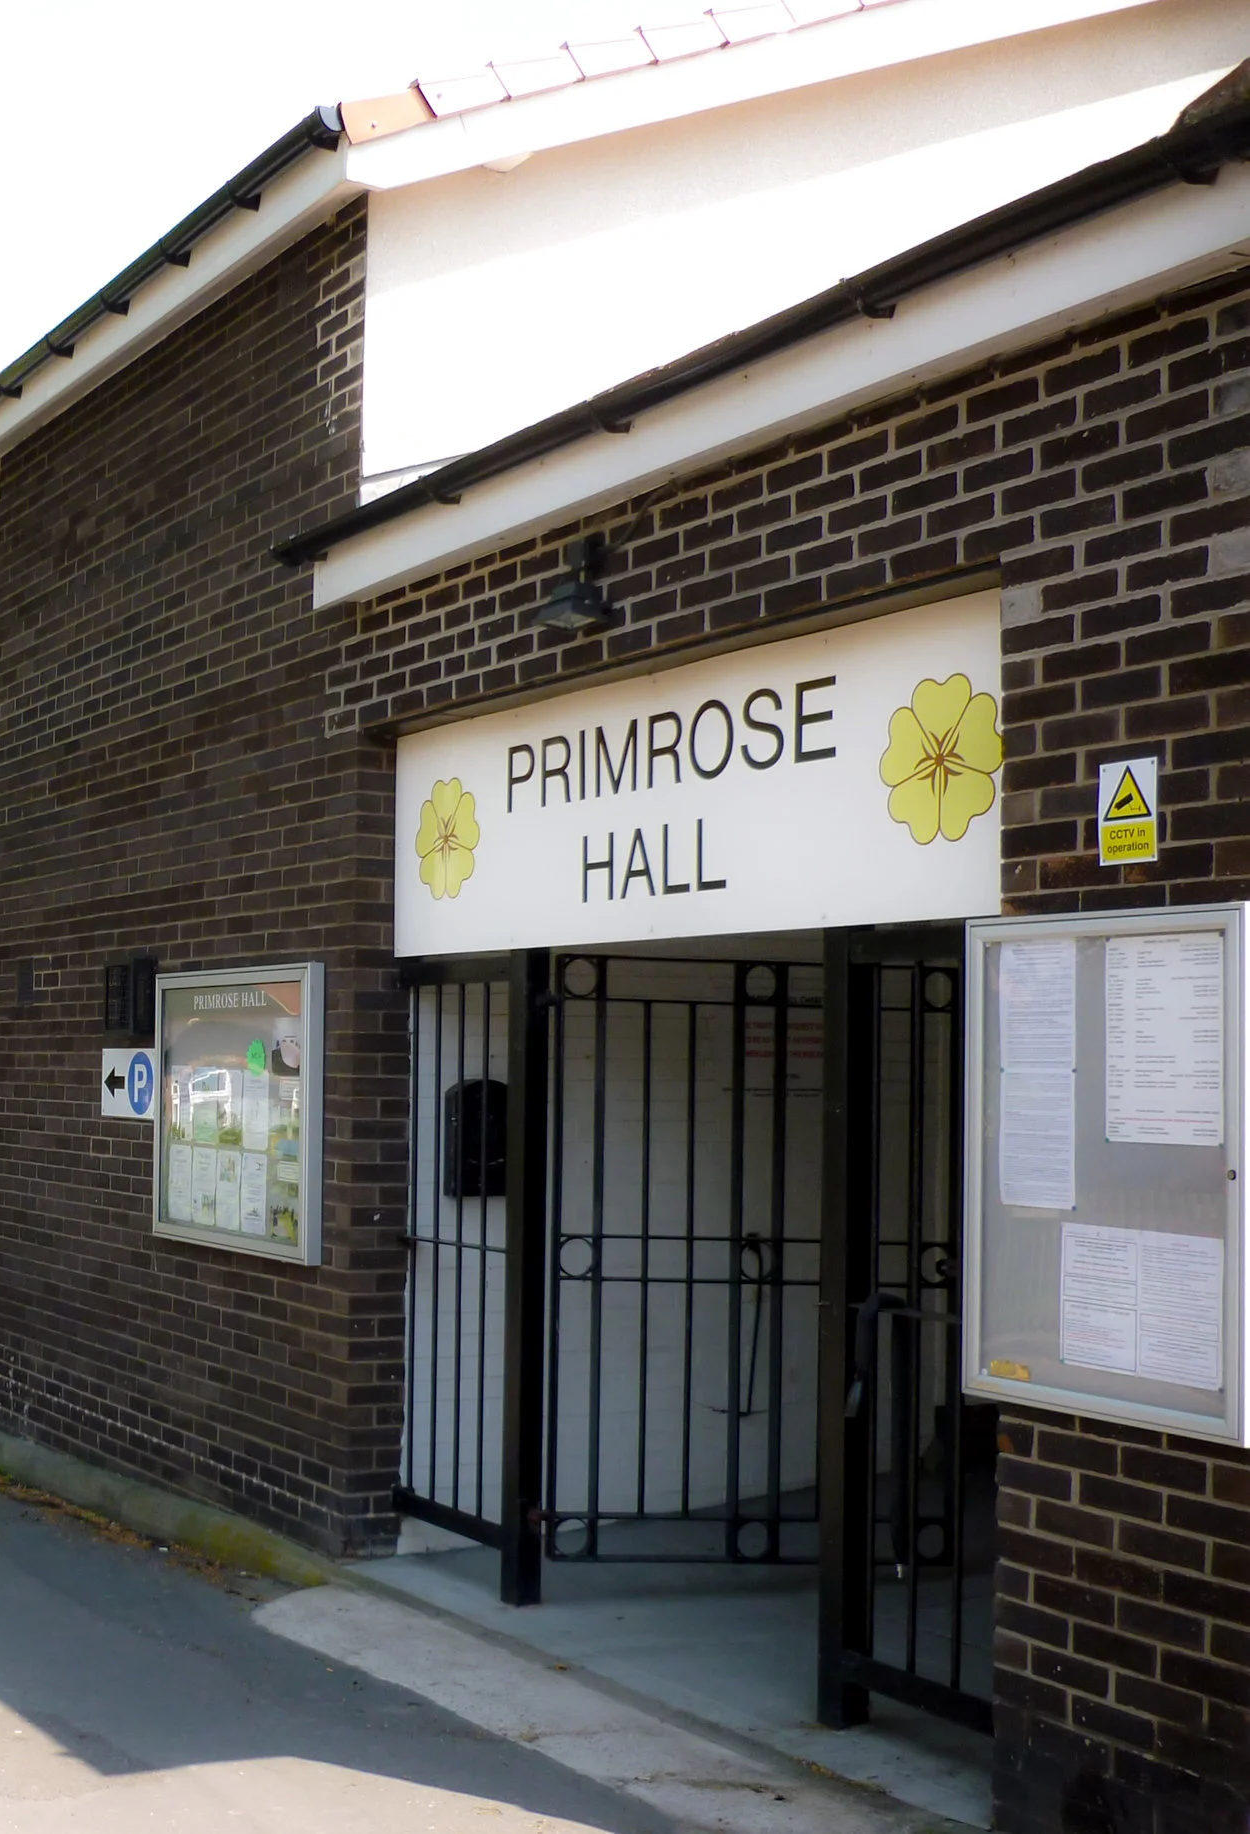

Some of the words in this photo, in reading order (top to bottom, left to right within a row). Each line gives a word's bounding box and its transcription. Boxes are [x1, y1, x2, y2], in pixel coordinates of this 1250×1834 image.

[506, 674, 837, 813] PRIMROSE
[1107, 841, 1149, 855] operation
[1109, 828, 1135, 840] CCTV
[1137, 827, 1146, 837] in
[582, 818, 727, 903] HALL
[193, 992, 239, 1010] PRIMROSE
[241, 990, 267, 1007] HALL
[133, 1063, 148, 1103] P
